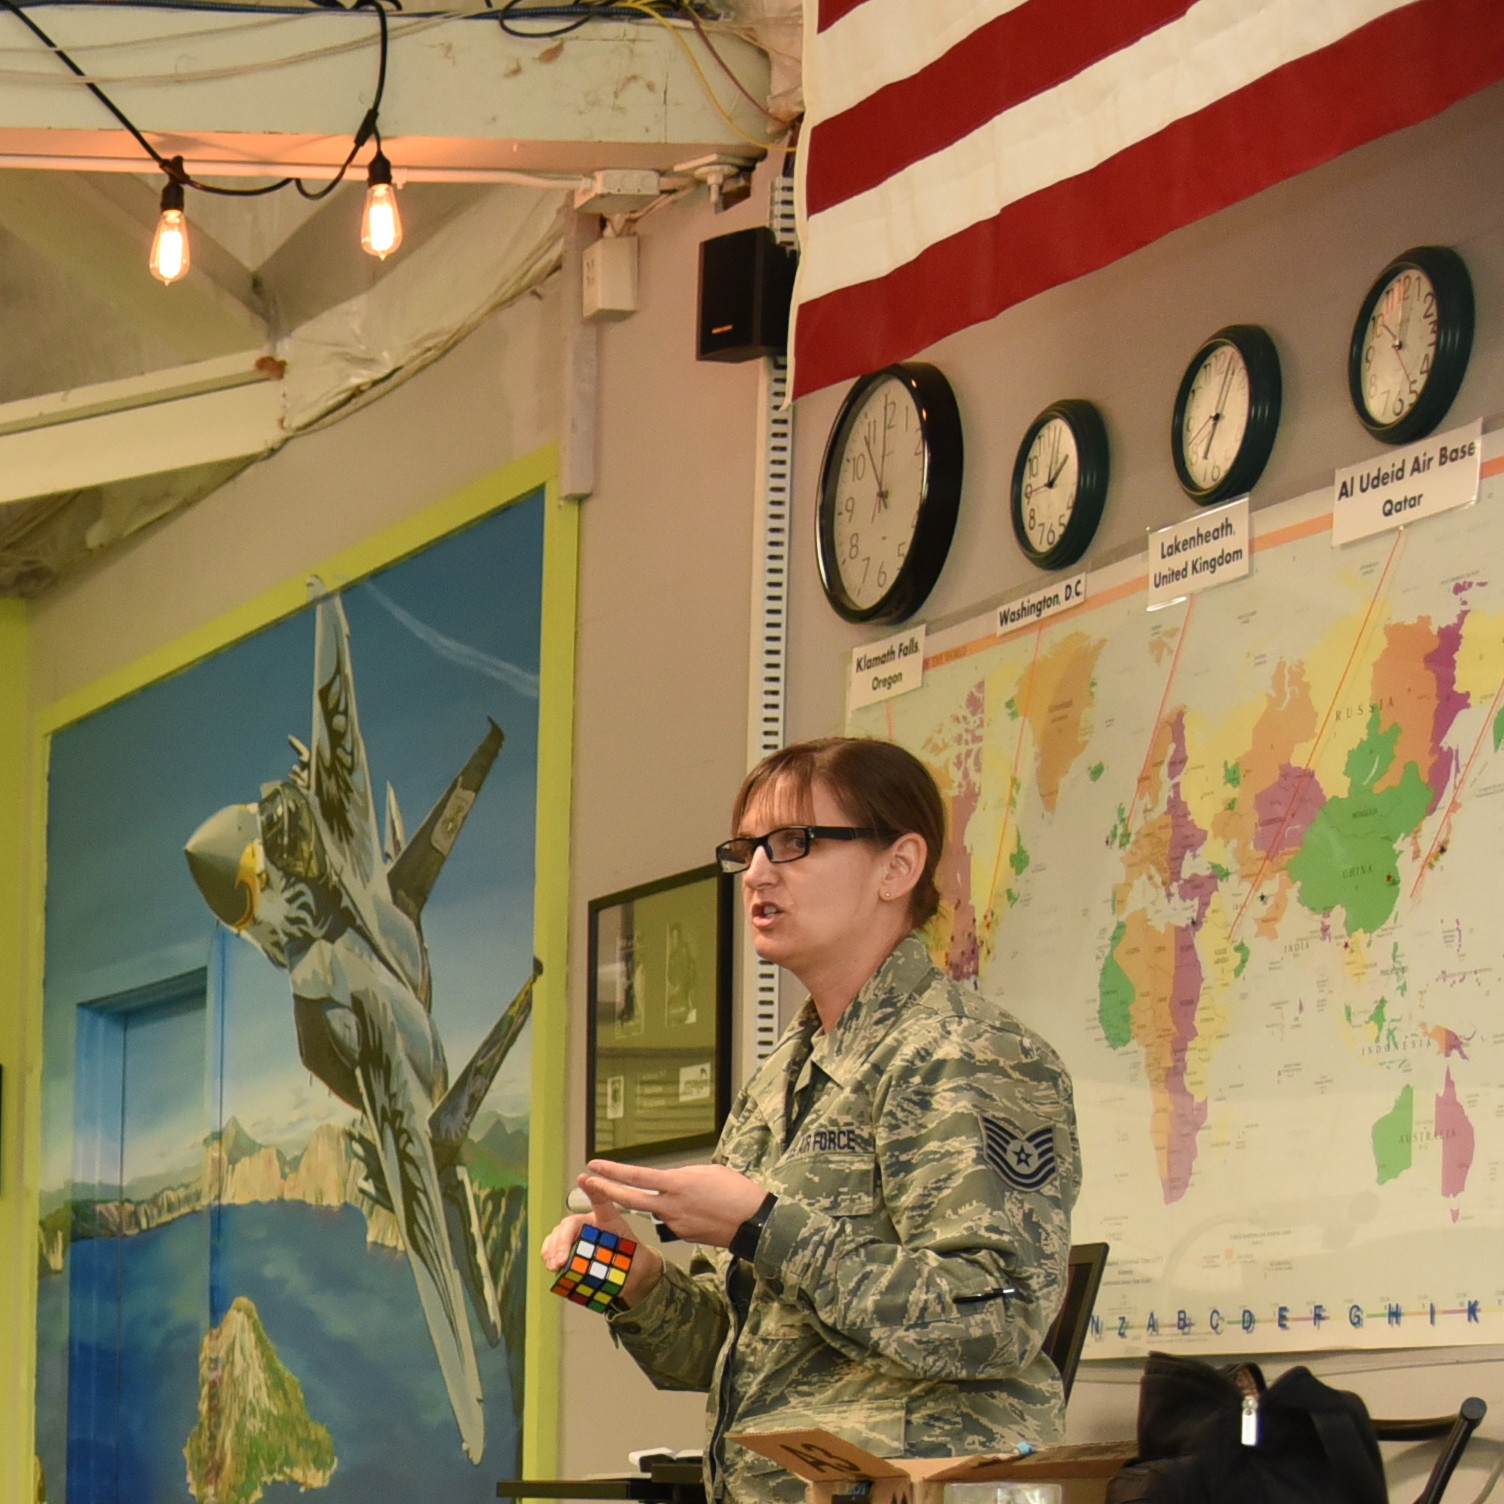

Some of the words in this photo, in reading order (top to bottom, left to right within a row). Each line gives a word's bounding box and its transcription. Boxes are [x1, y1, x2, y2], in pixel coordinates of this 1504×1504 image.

[1423, 292, 1435, 320] 2
[1365, 346, 1375, 373] 9
[1420, 353, 1430, 375] 4
[1381, 389, 1390, 417] 7
[1393, 390, 1404, 416] 6
[851, 453, 866, 481] 10
[1028, 455, 1039, 479] 10
[1337, 478, 1354, 502] Al
[1359, 462, 1405, 494] Udeid
[1409, 453, 1433, 478] Air
[1438, 440, 1476, 468] Base
[844, 496, 855, 523] 9
[1382, 492, 1423, 517] Qatar
[1028, 508, 1036, 530] 8
[849, 532, 859, 560] 8
[1038, 523, 1045, 545] 7
[1047, 523, 1055, 546] 6
[861, 556, 871, 584] 7
[877, 560, 887, 588] 6
[1153, 561, 1188, 589] United
[1191, 547, 1243, 577] Kingdom
[855, 644, 896, 673] Klamath
[871, 671, 903, 691] Oregon
[812, 1130, 856, 1151] FORCE
[1147, 1311, 1156, 1333] A
[1177, 1310, 1189, 1331] B
[1210, 1309, 1221, 1331] C
[1242, 1309, 1254, 1331] D
[1278, 1306, 1289, 1329] E
[1313, 1305, 1324, 1327] F
[1349, 1304, 1362, 1327] G
[1388, 1303, 1400, 1326] H
[1467, 1300, 1480, 1323] K
